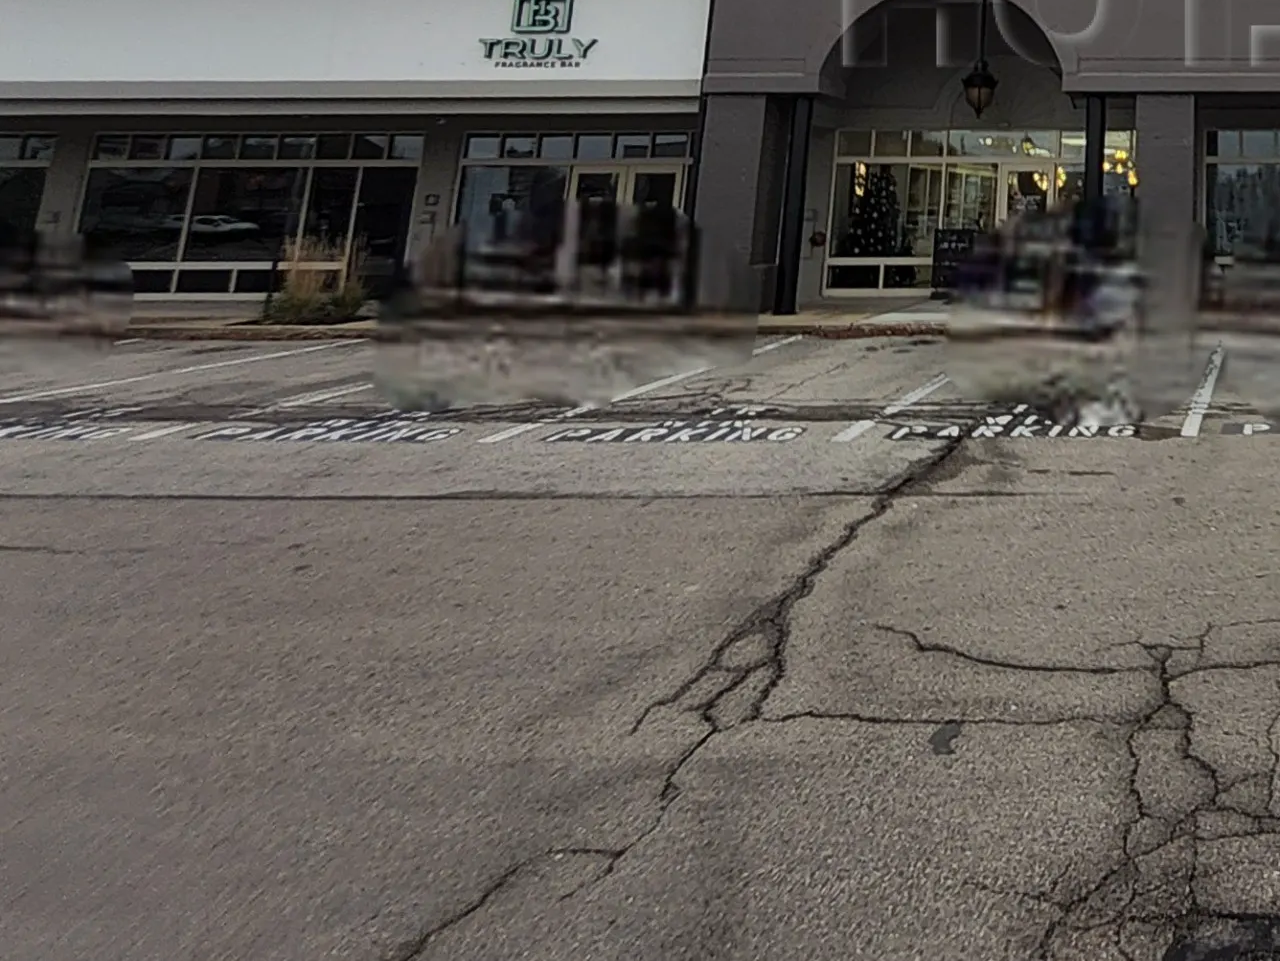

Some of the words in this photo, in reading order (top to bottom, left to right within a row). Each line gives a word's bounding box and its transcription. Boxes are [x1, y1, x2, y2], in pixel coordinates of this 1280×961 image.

[478, 38, 598, 60] TRULY
[195, 425, 461, 442] PARKING
[545, 426, 805, 442] PARKING
[892, 424, 1137, 439] PARKING
